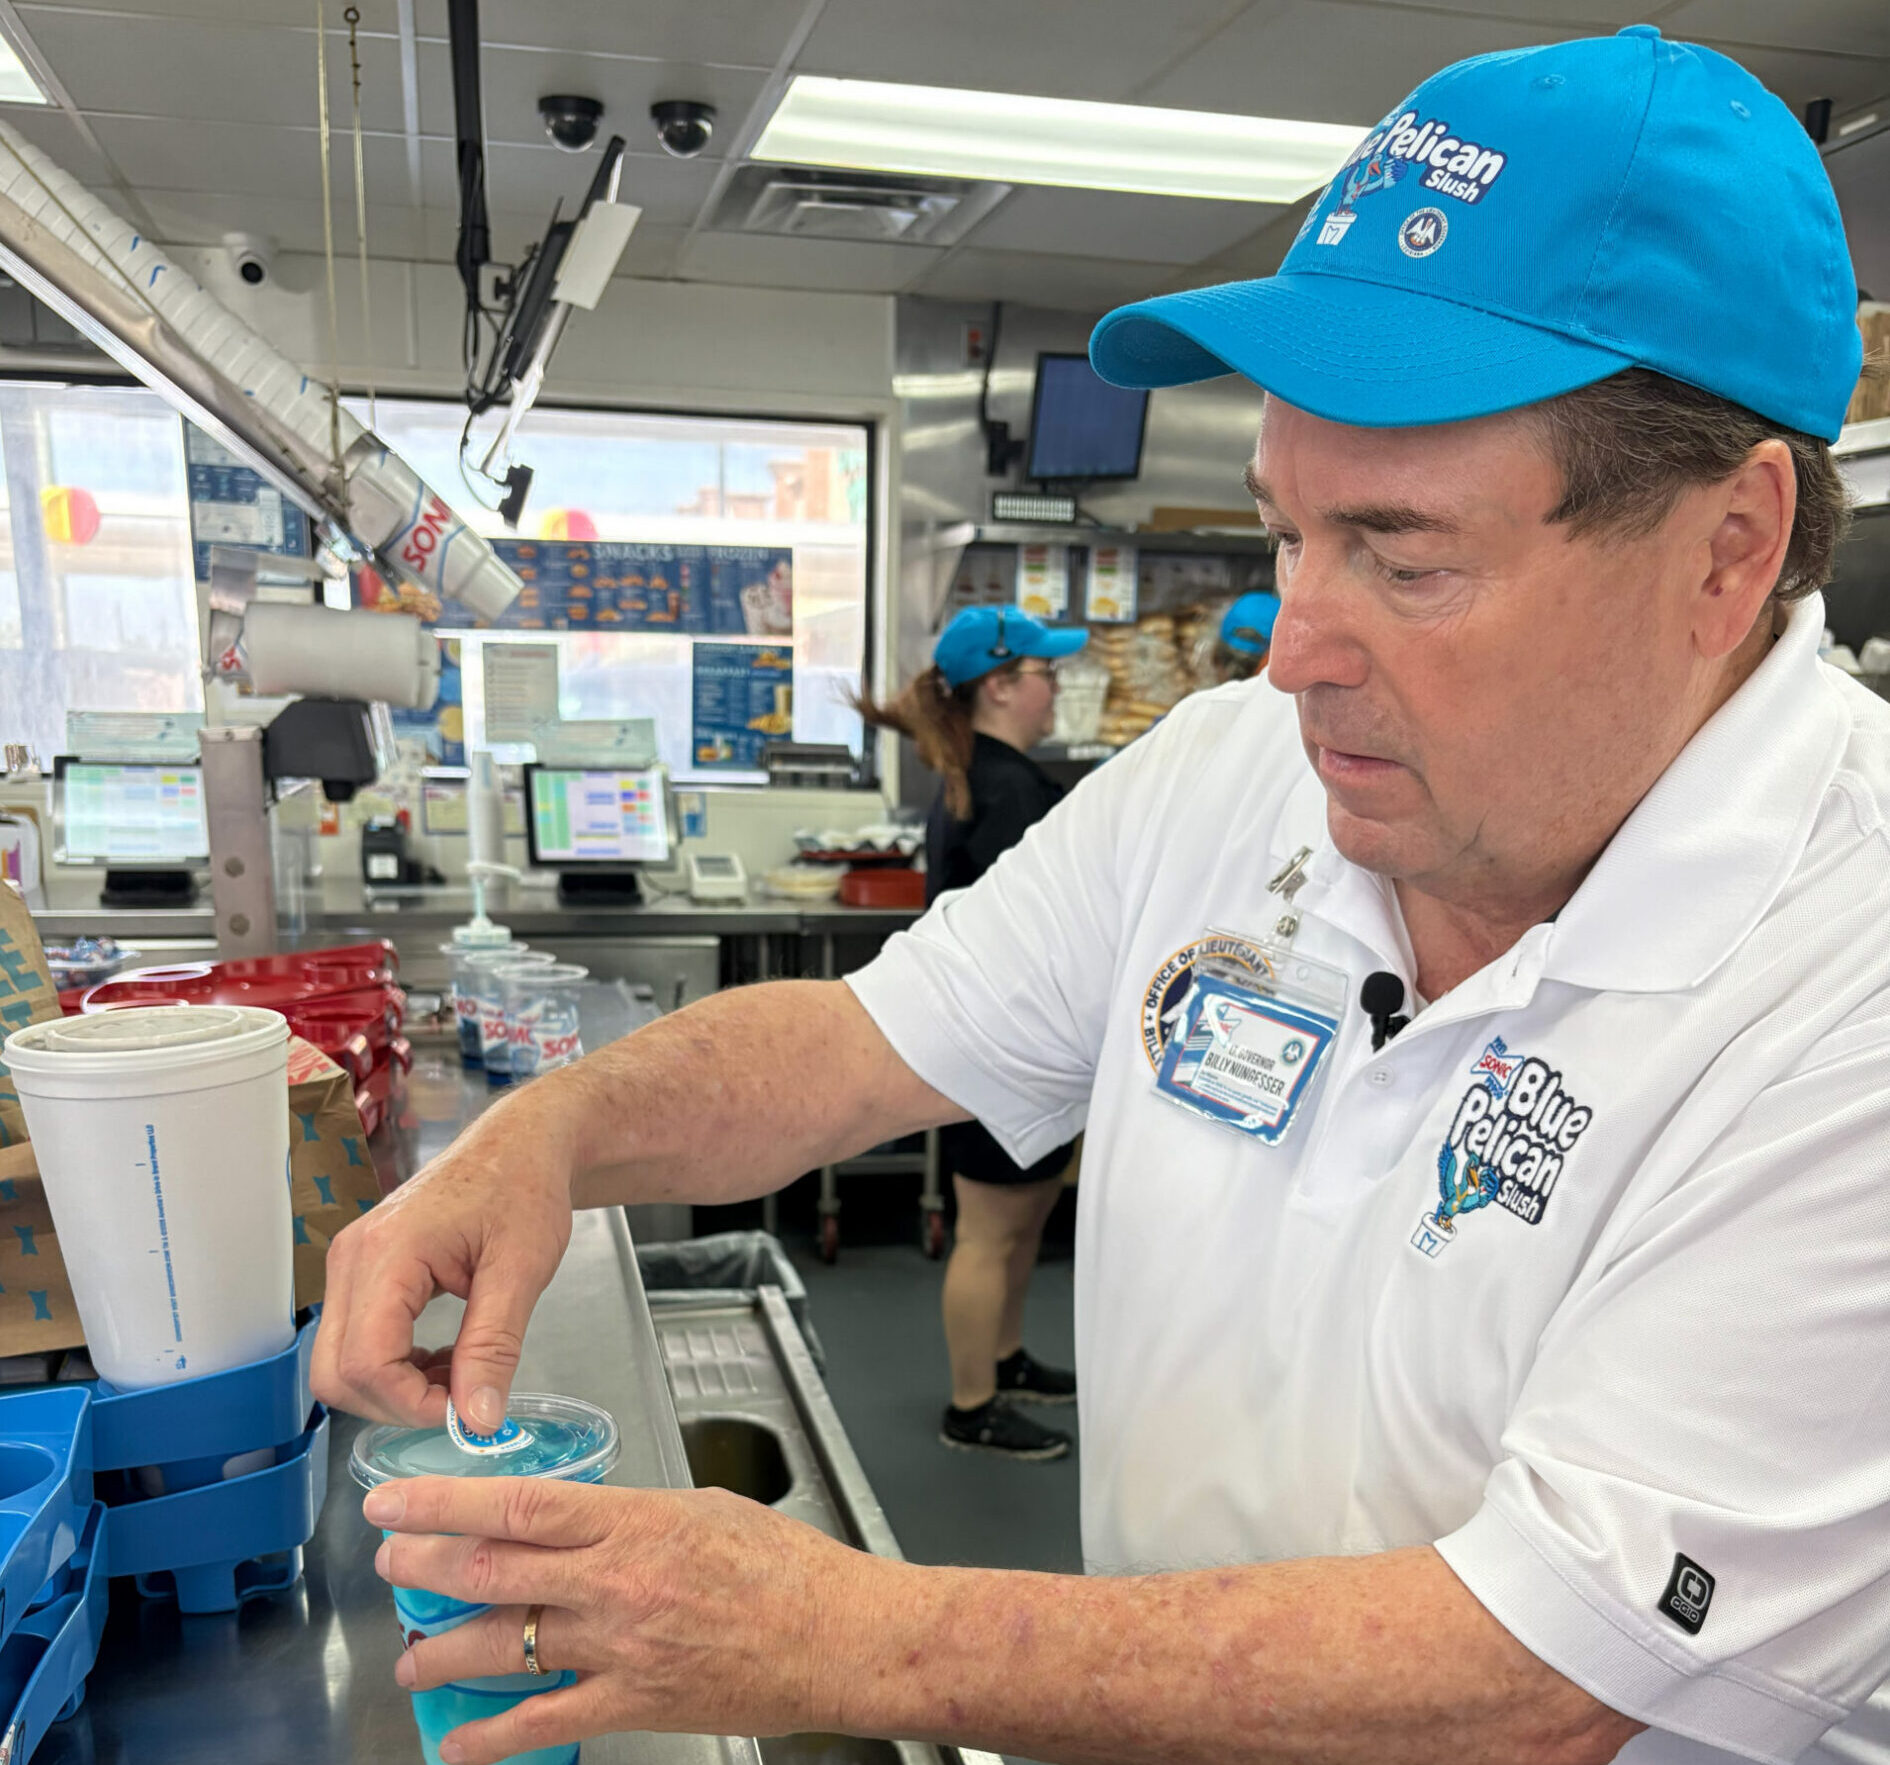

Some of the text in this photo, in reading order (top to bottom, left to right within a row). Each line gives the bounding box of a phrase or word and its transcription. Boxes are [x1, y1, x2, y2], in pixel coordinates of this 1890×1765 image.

[1378, 110, 1506, 186] Pelican
[1425, 169, 1481, 203] Slush
[1146, 962, 1179, 1009] OFFICE
[1179, 947, 1196, 965] OF
[1204, 1052, 1232, 1074] BILLY
[1229, 1061, 1286, 1097] NUNGESSER
[1238, 1049, 1276, 1072] GOVERNOR
[1479, 1053, 1513, 1080] SONIC
[1506, 1058, 1592, 1150] Blue
[1450, 1084, 1563, 1197] Pelican
[1496, 1180, 1542, 1222] Slush
